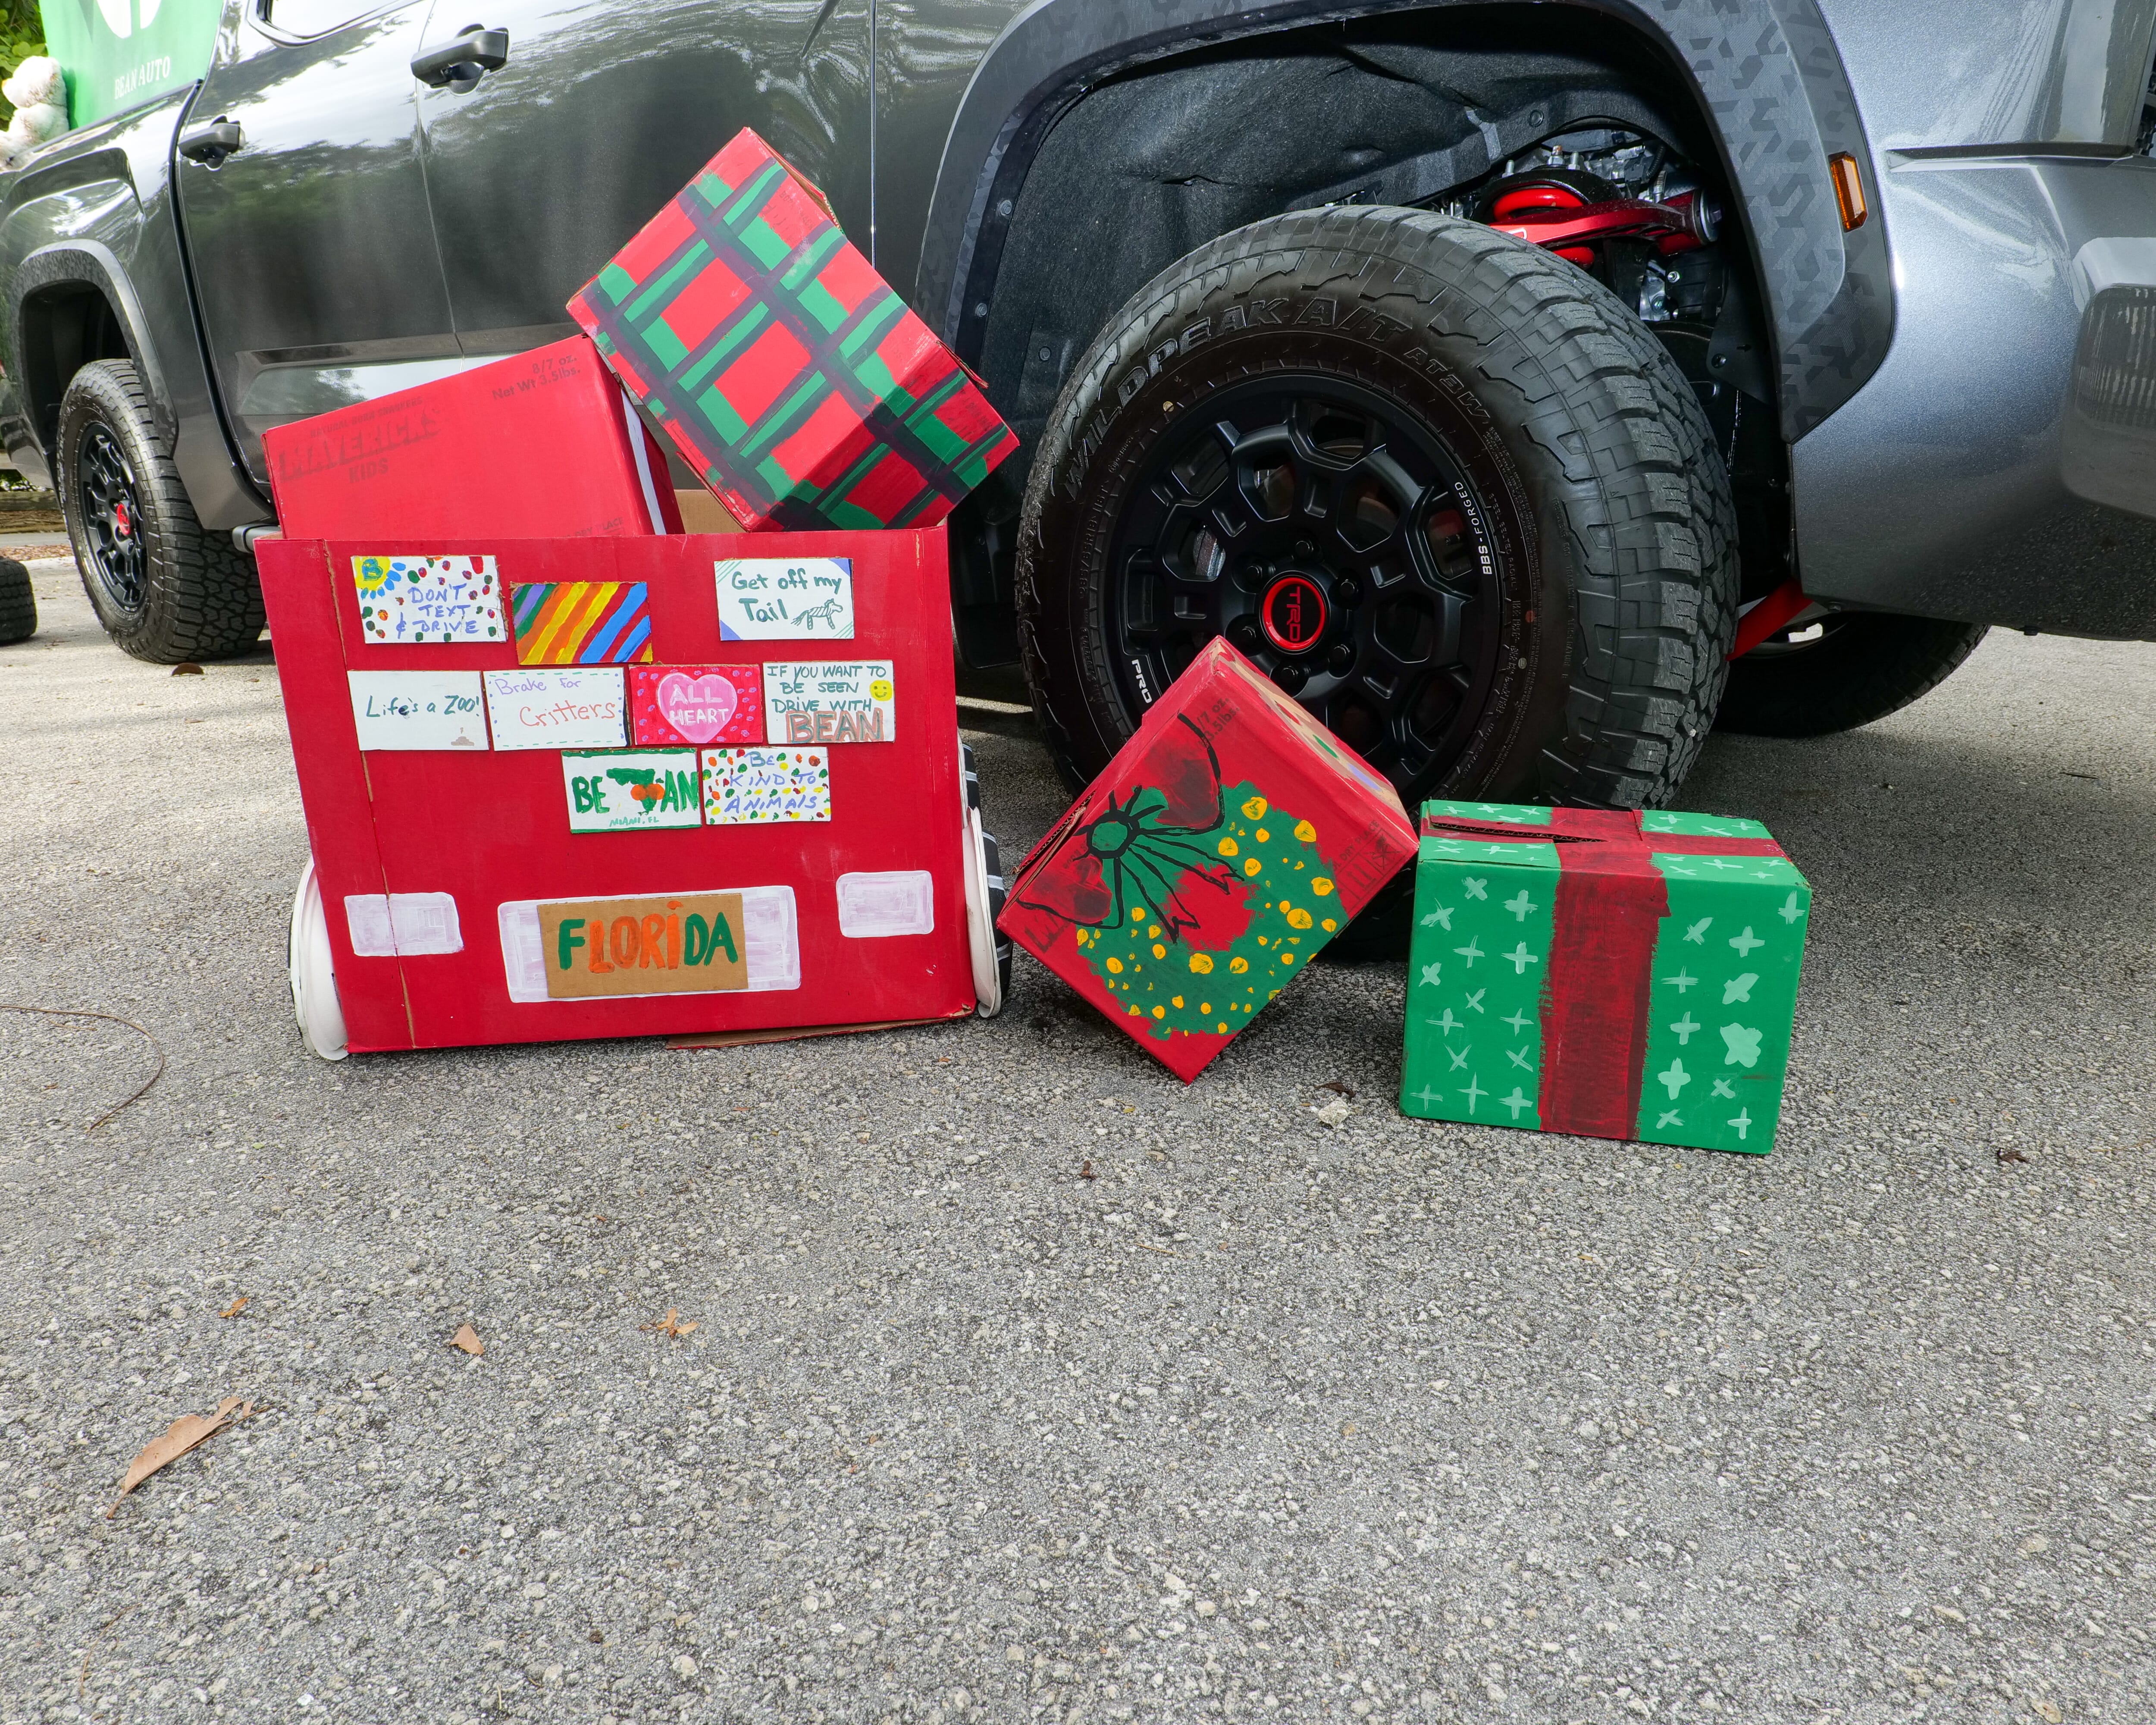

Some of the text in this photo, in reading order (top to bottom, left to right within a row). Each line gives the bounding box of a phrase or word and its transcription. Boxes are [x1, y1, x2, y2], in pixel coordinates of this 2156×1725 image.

[115, 56, 170, 100] BEAN AUTO
[532, 354, 578, 375] 8/7 oz.
[492, 366, 581, 401] Net Wt 3.5lbs.
[1404, 347, 1490, 419] AT3W
[1064, 297, 1413, 501] WILDPEAK A/T
[349, 458, 389, 484] KIDS
[1455, 482, 1483, 534] FORGED
[1487, 492, 1503, 521] STEEL
[1498, 521, 1512, 555] BELTED
[1507, 556, 1517, 588] RADIAL
[1478, 545, 1492, 574] BBS
[407, 583, 467, 603] DON'T
[732, 568, 842, 595] Get off my
[418, 605, 471, 617] TEXT
[738, 598, 788, 622] Tail
[1286, 586, 1300, 642] TRD
[396, 612, 479, 639] & DRIVE
[495, 678, 547, 695] Brake
[767, 665, 886, 684] IF YOU WANT TO
[1131, 659, 1152, 703] PRO
[669, 684, 723, 706] ALL
[780, 682, 859, 694] BE SEEN
[366, 695, 418, 717] Life's
[426, 702, 436, 712] a
[520, 700, 615, 726] Critters
[668, 708, 729, 726] HEART
[830, 698, 871, 712] WITH
[786, 707, 883, 743] BEAN
[729, 771, 816, 787] KIND TO
[1340, 839, 1357, 860] DRY
